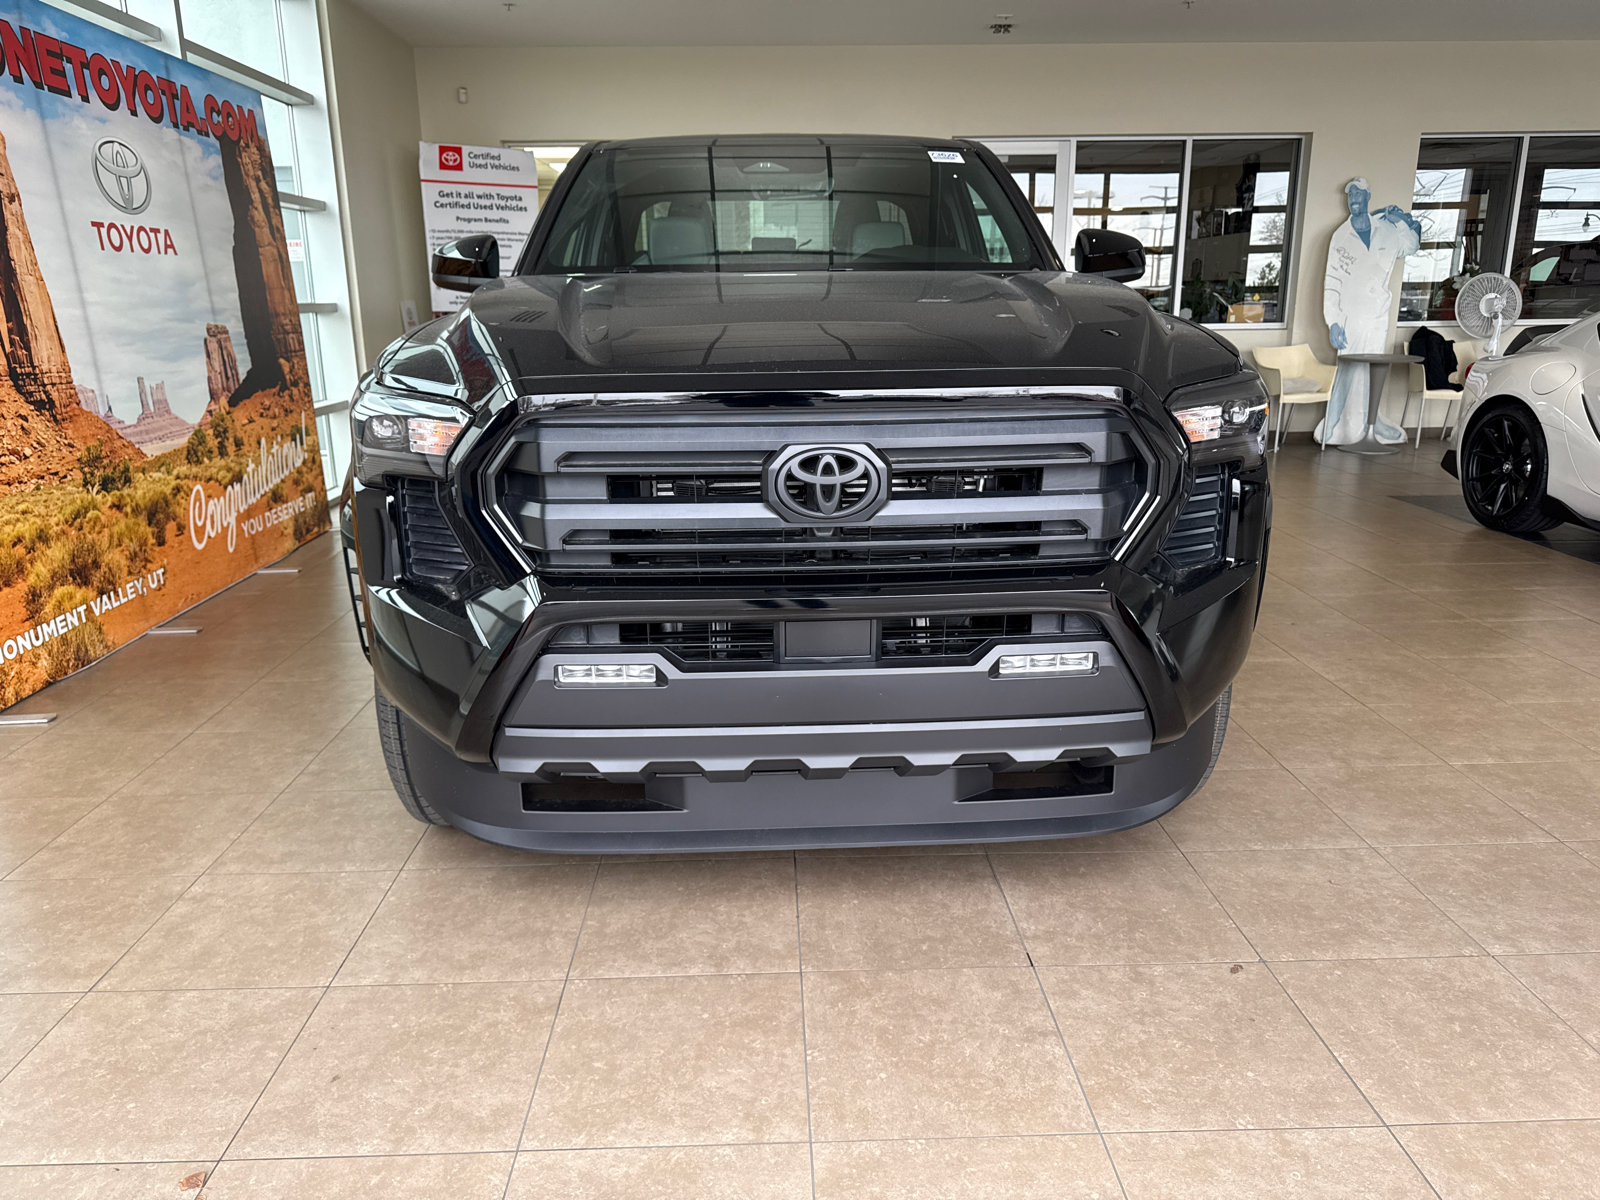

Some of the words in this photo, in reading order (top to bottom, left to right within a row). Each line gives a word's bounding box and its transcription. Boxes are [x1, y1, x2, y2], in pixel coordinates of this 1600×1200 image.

[0, 19, 259, 147] NETOYOTA.COM
[468, 151, 501, 161] Certified
[468, 161, 488, 170] Used
[489, 162, 520, 172] Vehicles
[433, 200, 471, 210] Certified
[472, 202, 494, 211] Used
[495, 203, 528, 213] Vehicles
[438, 190, 454, 199] Get
[456, 190, 462, 199] it
[463, 191, 475, 200] all
[476, 192, 495, 201] with
[495, 192, 523, 203] Toyota
[456, 215, 484, 224] Program
[484, 217, 510, 225] Benefits
[91, 221, 178, 256] TOYOTA
[189, 410, 308, 553] Congratulations!
[241, 515, 263, 538] YOU
[264, 496, 306, 528] DESERVE
[305, 491, 317, 510] IT!
[0, 604, 87, 665] ONUMENT
[90, 576, 148, 618] VALLEY,
[148, 567, 166, 590] UT
